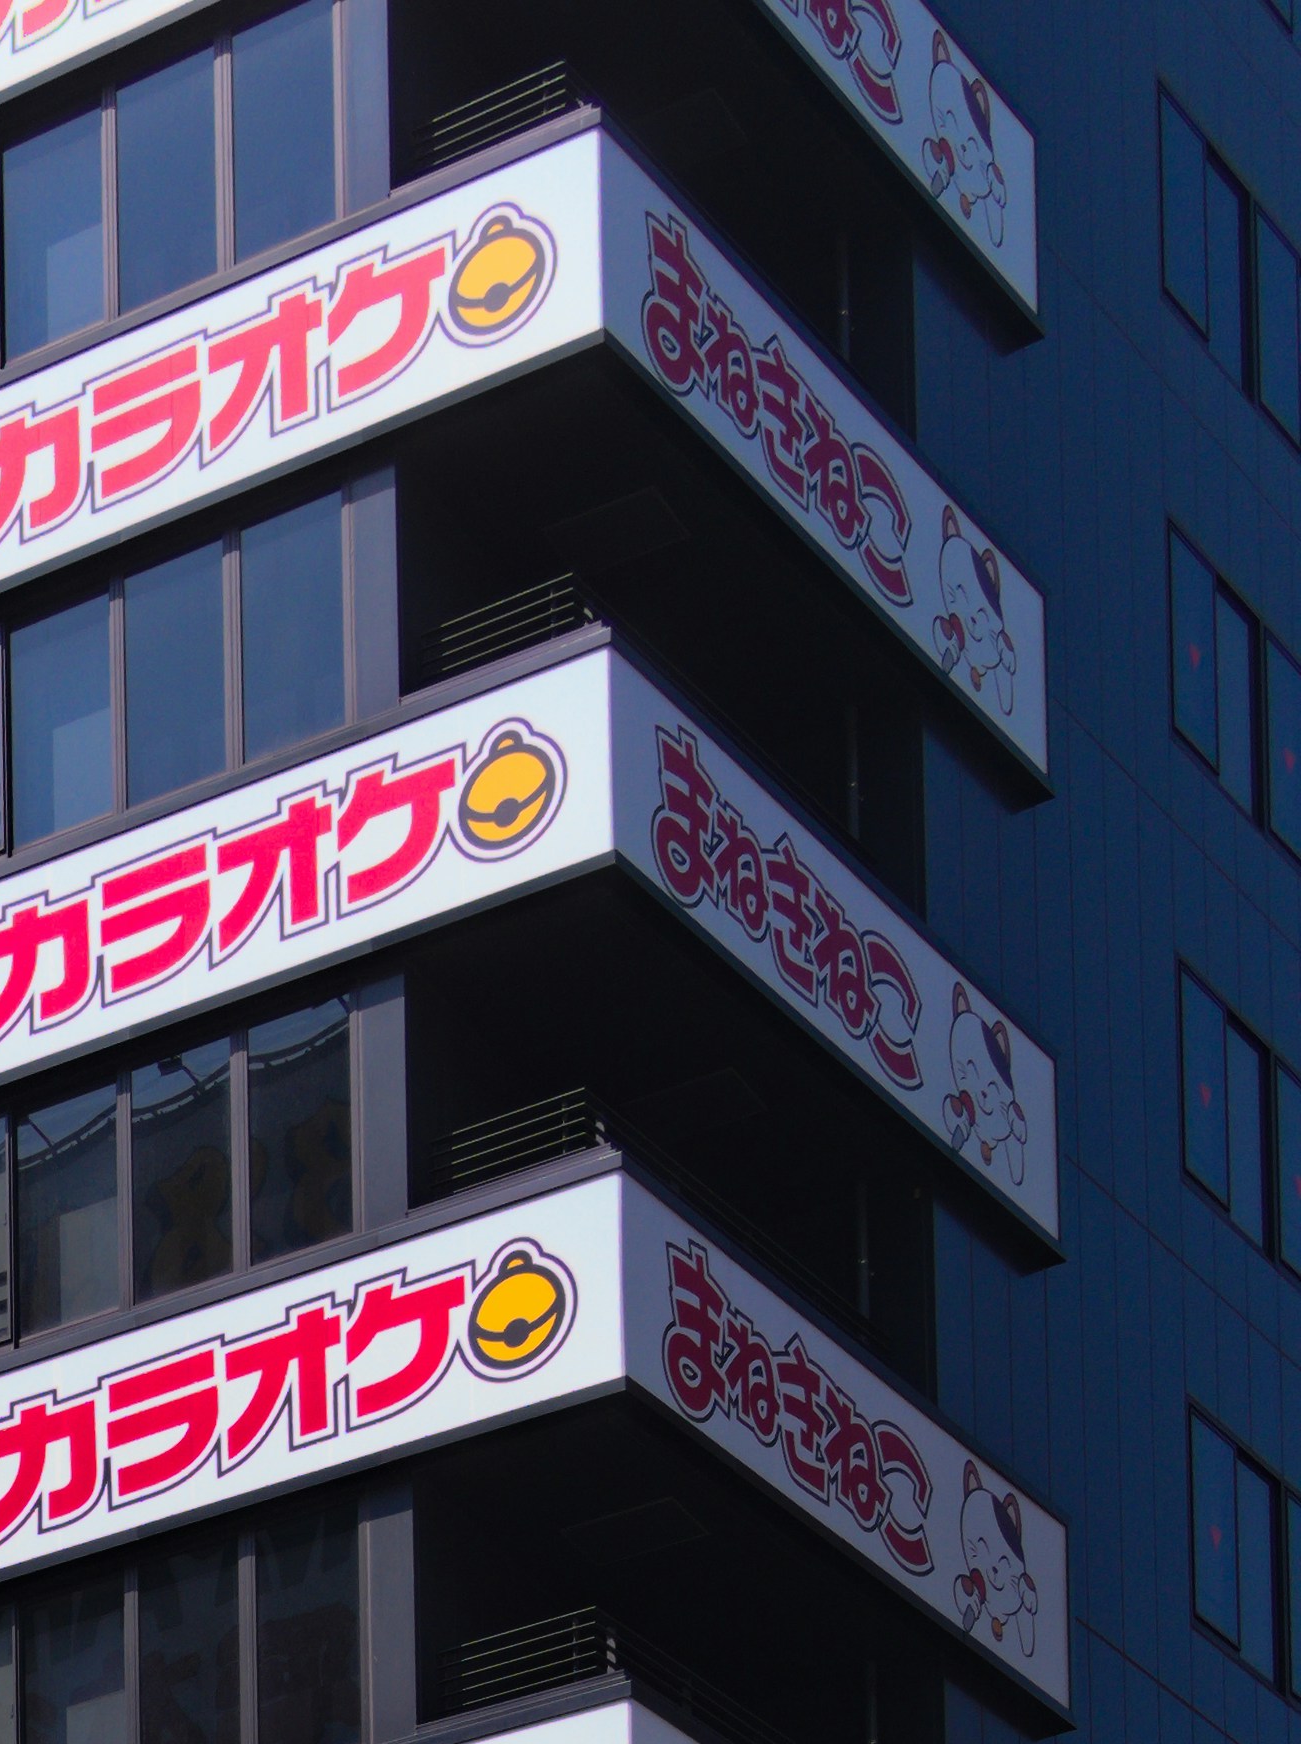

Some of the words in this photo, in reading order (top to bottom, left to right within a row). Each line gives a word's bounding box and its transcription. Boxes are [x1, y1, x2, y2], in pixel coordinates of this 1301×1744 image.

[643, 217, 911, 602] まねきねこ
[653, 733, 922, 1085] まねきねこ
[665, 1243, 933, 1576] まねきねこ
